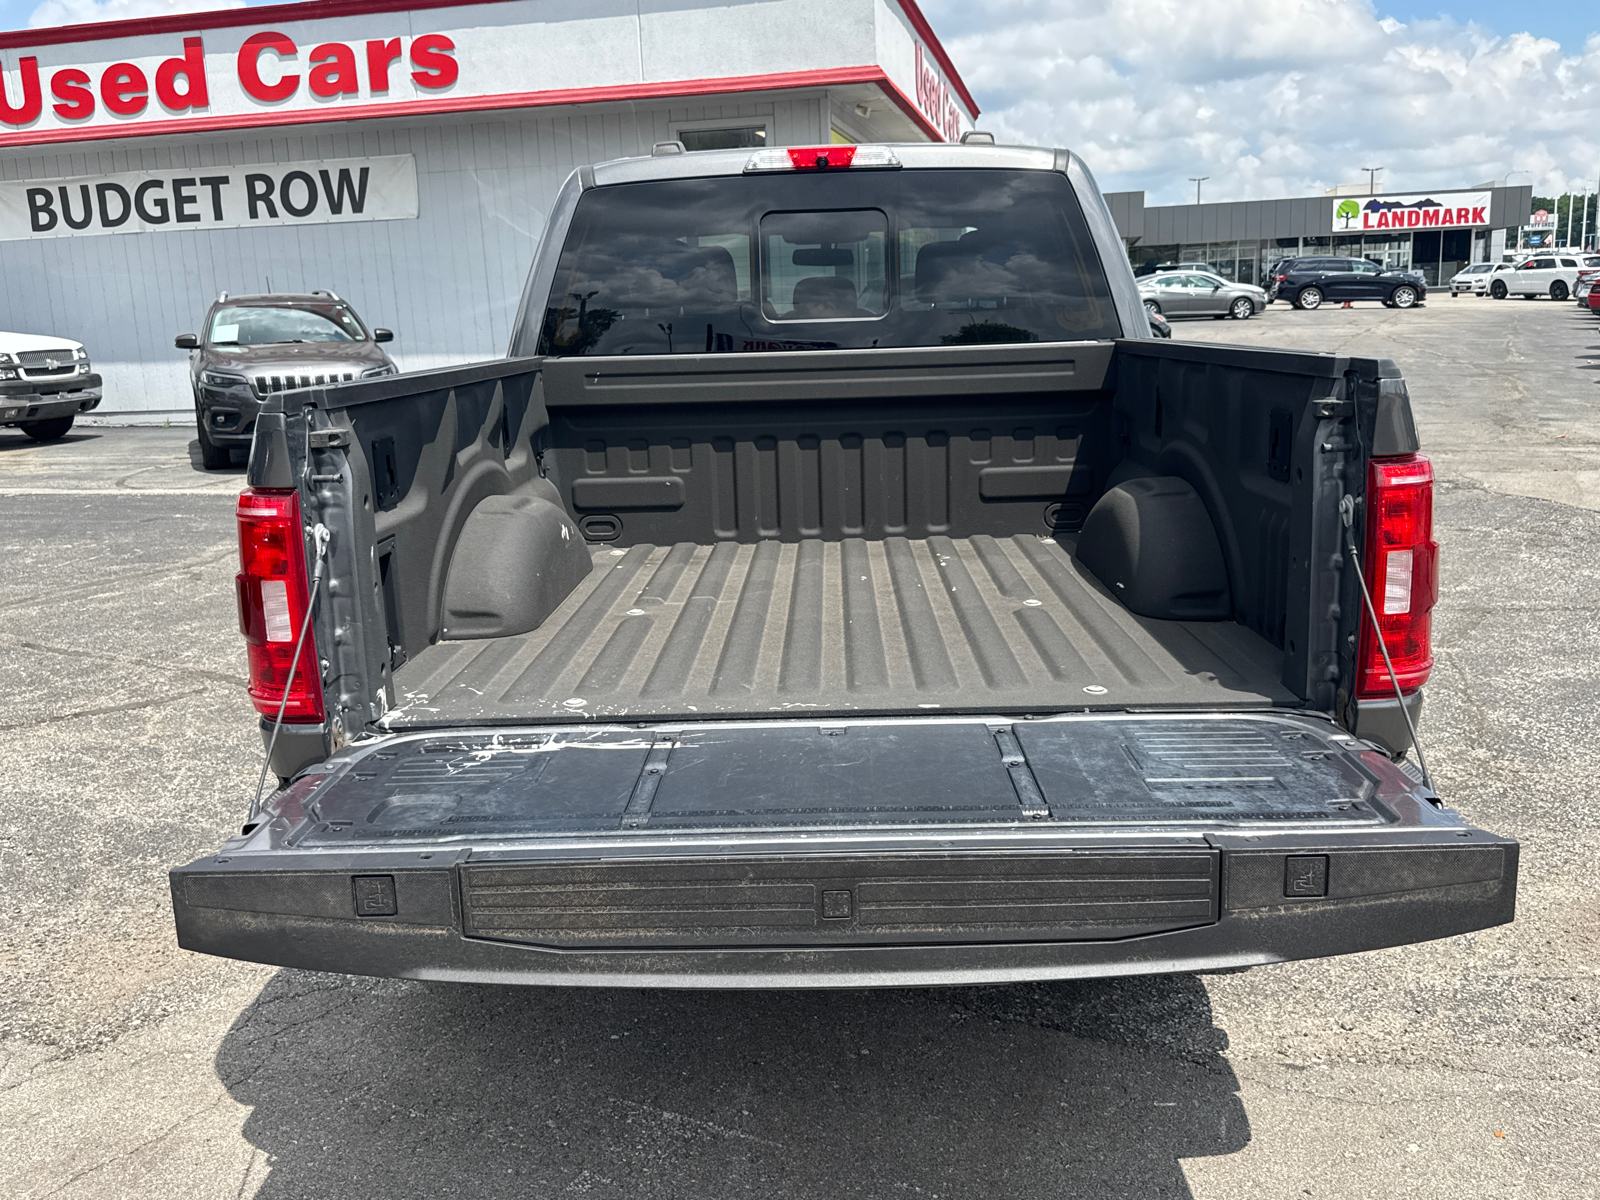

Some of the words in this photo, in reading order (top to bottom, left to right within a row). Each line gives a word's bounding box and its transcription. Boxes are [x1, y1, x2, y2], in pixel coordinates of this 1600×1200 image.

[0, 37, 209, 125] Used
[237, 31, 459, 102] Cars
[915, 39, 941, 129] Used
[26, 176, 230, 233] BUDGET
[245, 167, 370, 220] ROW
[1363, 206, 1487, 229] LANDMARK
